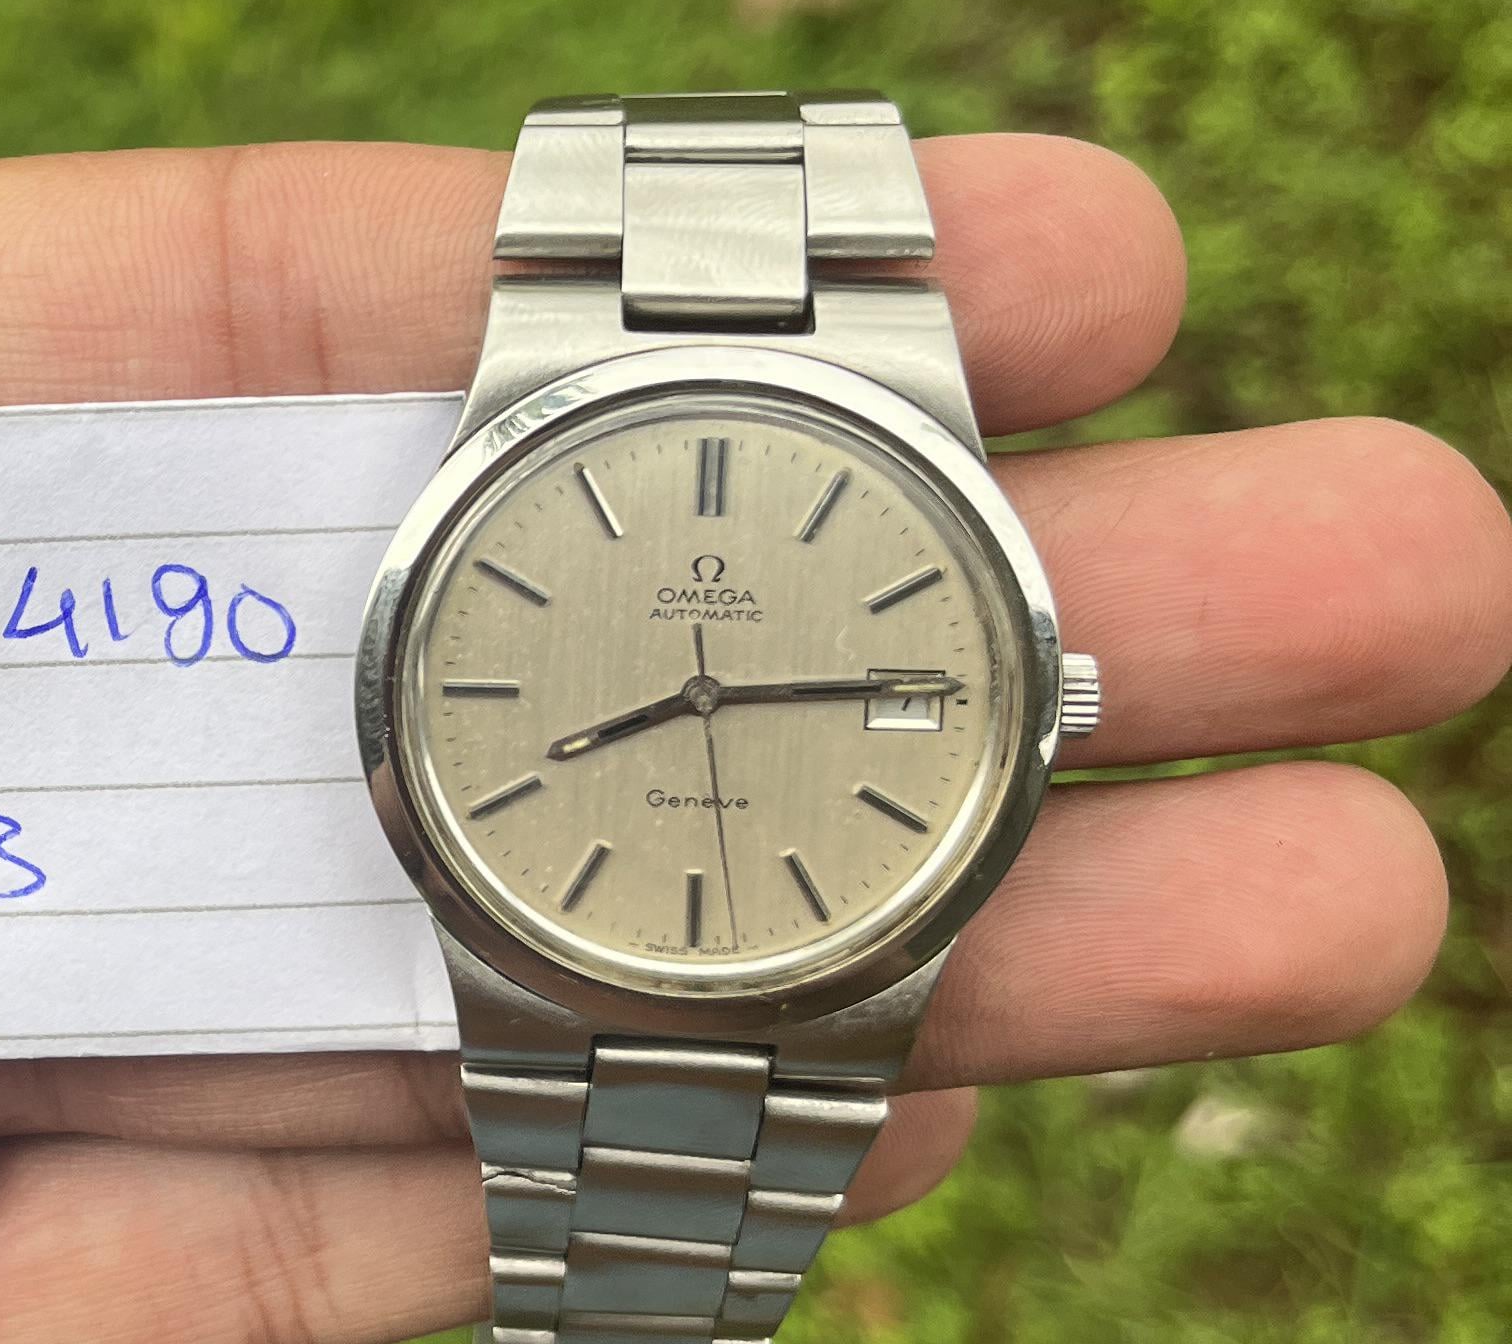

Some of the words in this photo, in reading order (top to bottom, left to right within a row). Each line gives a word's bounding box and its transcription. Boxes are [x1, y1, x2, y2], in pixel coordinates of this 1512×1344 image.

[656, 587, 756, 605] OMEGA
[649, 608, 764, 622] AUTOMATIC
[645, 942, 689, 956] SWISS
[698, 944, 740, 956] MADE
